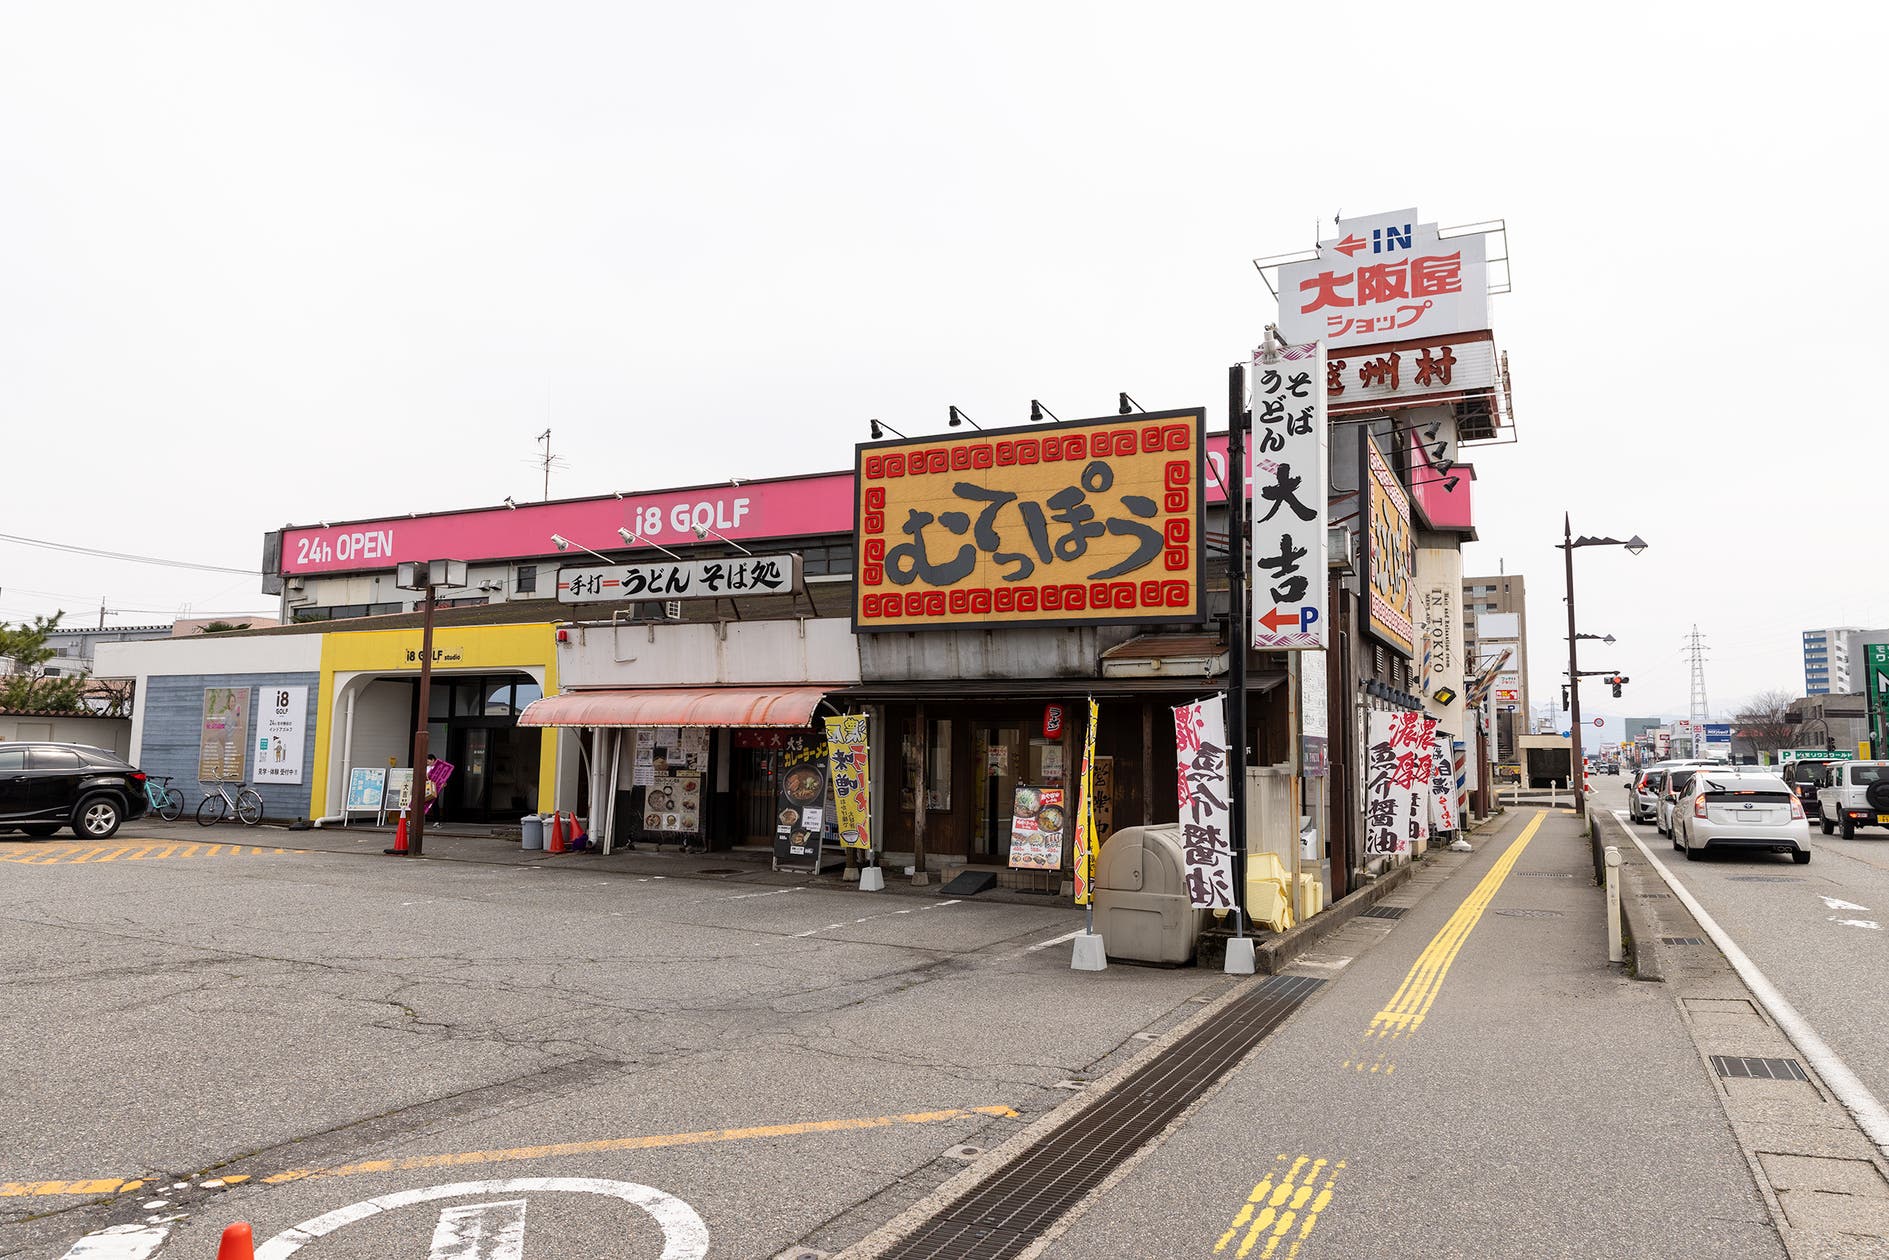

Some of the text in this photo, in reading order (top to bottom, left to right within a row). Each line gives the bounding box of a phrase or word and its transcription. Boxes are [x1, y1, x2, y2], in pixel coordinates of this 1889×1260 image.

[1373, 224, 1412, 254] IN
[1299, 250, 1462, 315] 大阪屋
[1327, 299, 1433, 339] ショップ
[1259, 370, 1286, 453] うどん
[1285, 371, 1315, 437] そば
[635, 497, 751, 535] i8 GOLF
[885, 461, 1164, 587] むてっぽう
[1257, 462, 1318, 604] 大吉
[297, 528, 394, 565] 24h OPEN
[569, 559, 785, 597] 手打 うどん そば処
[1301, 606, 1319, 633] P
[1432, 589, 1444, 673] IN TOKYO
[406, 650, 416, 662] i8
[418, 650, 443, 661] GLF
[276, 691, 289, 708] i8
[770, 734, 781, 746] 大
[784, 741, 829, 768] カレーラーメン
[786, 736, 804, 751] 大吉
[1389, 711, 1420, 791] 濃厚
[1783, 751, 1791, 760] P
[1367, 741, 1399, 854] 魚介醤油
